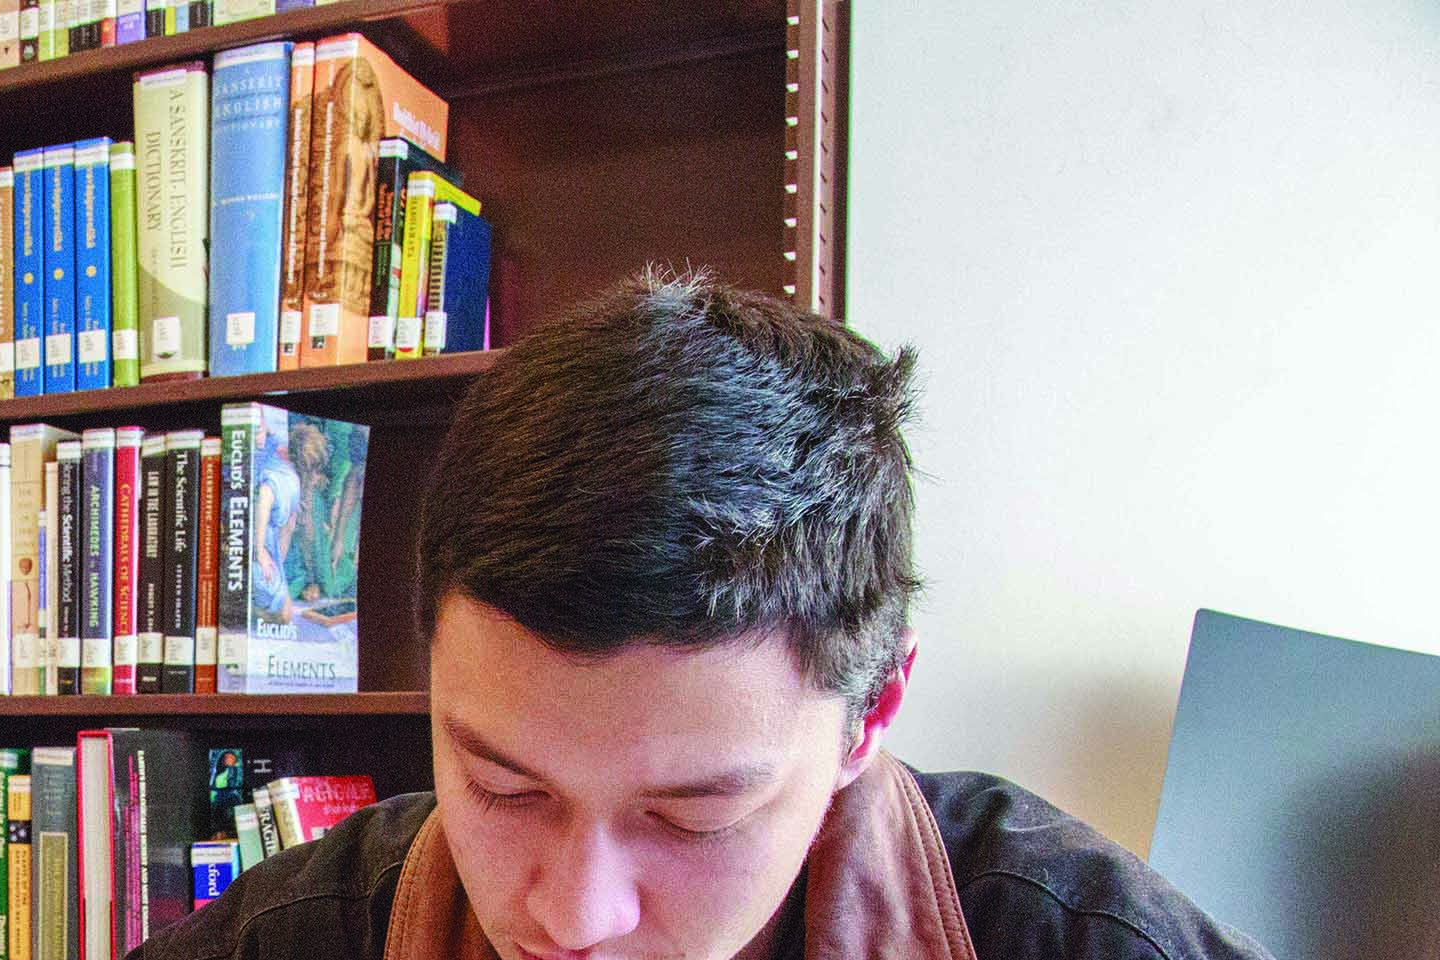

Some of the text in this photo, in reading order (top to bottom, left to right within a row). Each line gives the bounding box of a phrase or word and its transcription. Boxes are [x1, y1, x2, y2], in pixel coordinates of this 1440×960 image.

[144, 130, 161, 233] DICTIONARY
[175, 453, 188, 474] The
[119, 483, 131, 562] CATHEDRALS
[175, 477, 188, 528] Scientific
[226, 429, 248, 592] EUCLID'S ELEMENTS
[62, 496, 73, 603] the Scientific Method
[88, 485, 101, 628] ARCHIMEDES HAWKING
[175, 530, 188, 553] Life
[267, 655, 336, 681] ELEMENTS
[208, 864, 220, 897] xford
